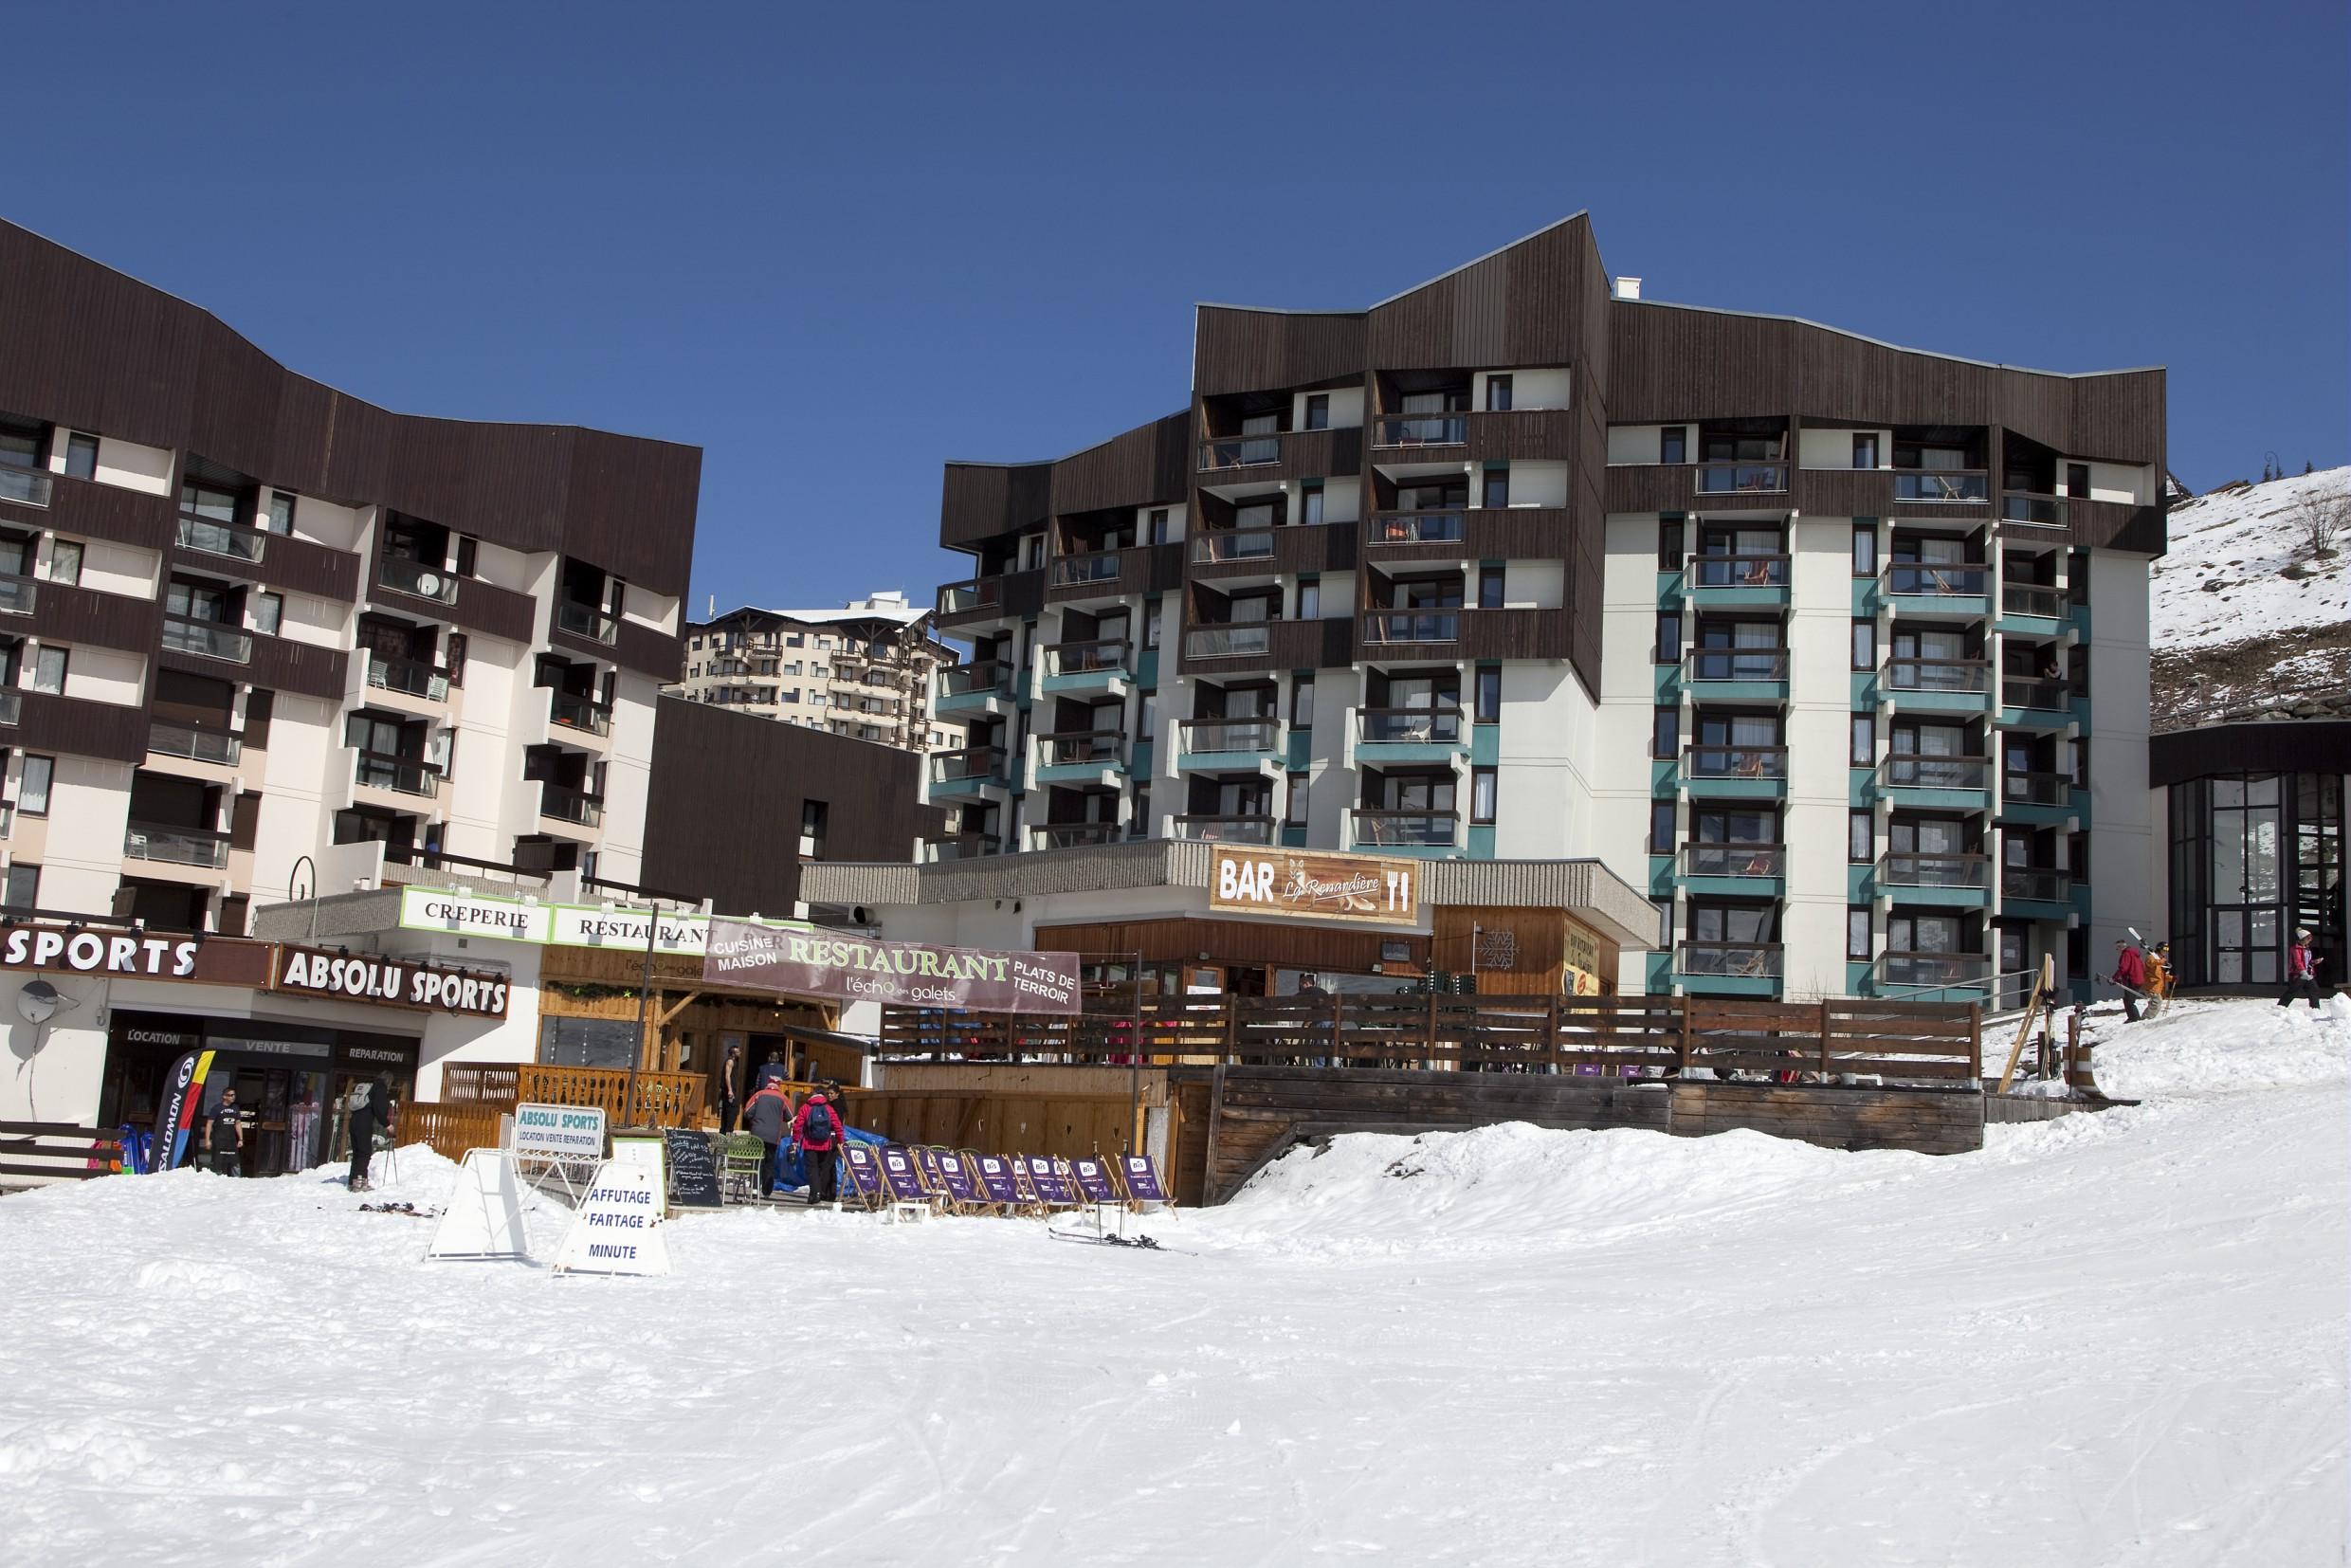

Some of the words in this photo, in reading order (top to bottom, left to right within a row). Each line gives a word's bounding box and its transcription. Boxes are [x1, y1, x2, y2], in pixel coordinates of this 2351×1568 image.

[1219, 859, 1275, 903] BAR
[1283, 881, 1303, 903] La
[1303, 872, 1380, 895] Renardière
[425, 903, 529, 929] CREPERIE
[579, 920, 718, 944] RESTAURANT
[5, 929, 197, 975] SPORTS
[714, 937, 775, 956] CUISINE
[676, 963, 704, 977] gale
[718, 952, 777, 972] MAISON
[788, 936, 1010, 982] RESTAURANT
[283, 952, 402, 999] ABSOLU
[410, 971, 507, 1014] SPORTS
[1013, 960, 1055, 983] PLATS
[1058, 974, 1075, 991] DE
[847, 975, 895, 995] l'écho
[897, 985, 909, 995] des
[911, 985, 956, 1002] galets
[1013, 976, 1068, 1005] TERROIR
[127, 1029, 180, 1045] LOCATION
[246, 1040, 291, 1053] VENTE
[349, 1048, 404, 1063] REPARATION
[519, 1110, 557, 1128] ABSOLU
[561, 1114, 599, 1131] SPORTS
[158, 1092, 182, 1173] SALOMON
[519, 1131, 545, 1142] LOCATION
[545, 1133, 563, 1143] VENTE
[563, 1134, 595, 1145] REPARATION
[590, 1189, 651, 1205] AFFUTAGE
[589, 1212, 644, 1229] FARTAGE
[589, 1244, 637, 1260] MINUTE
